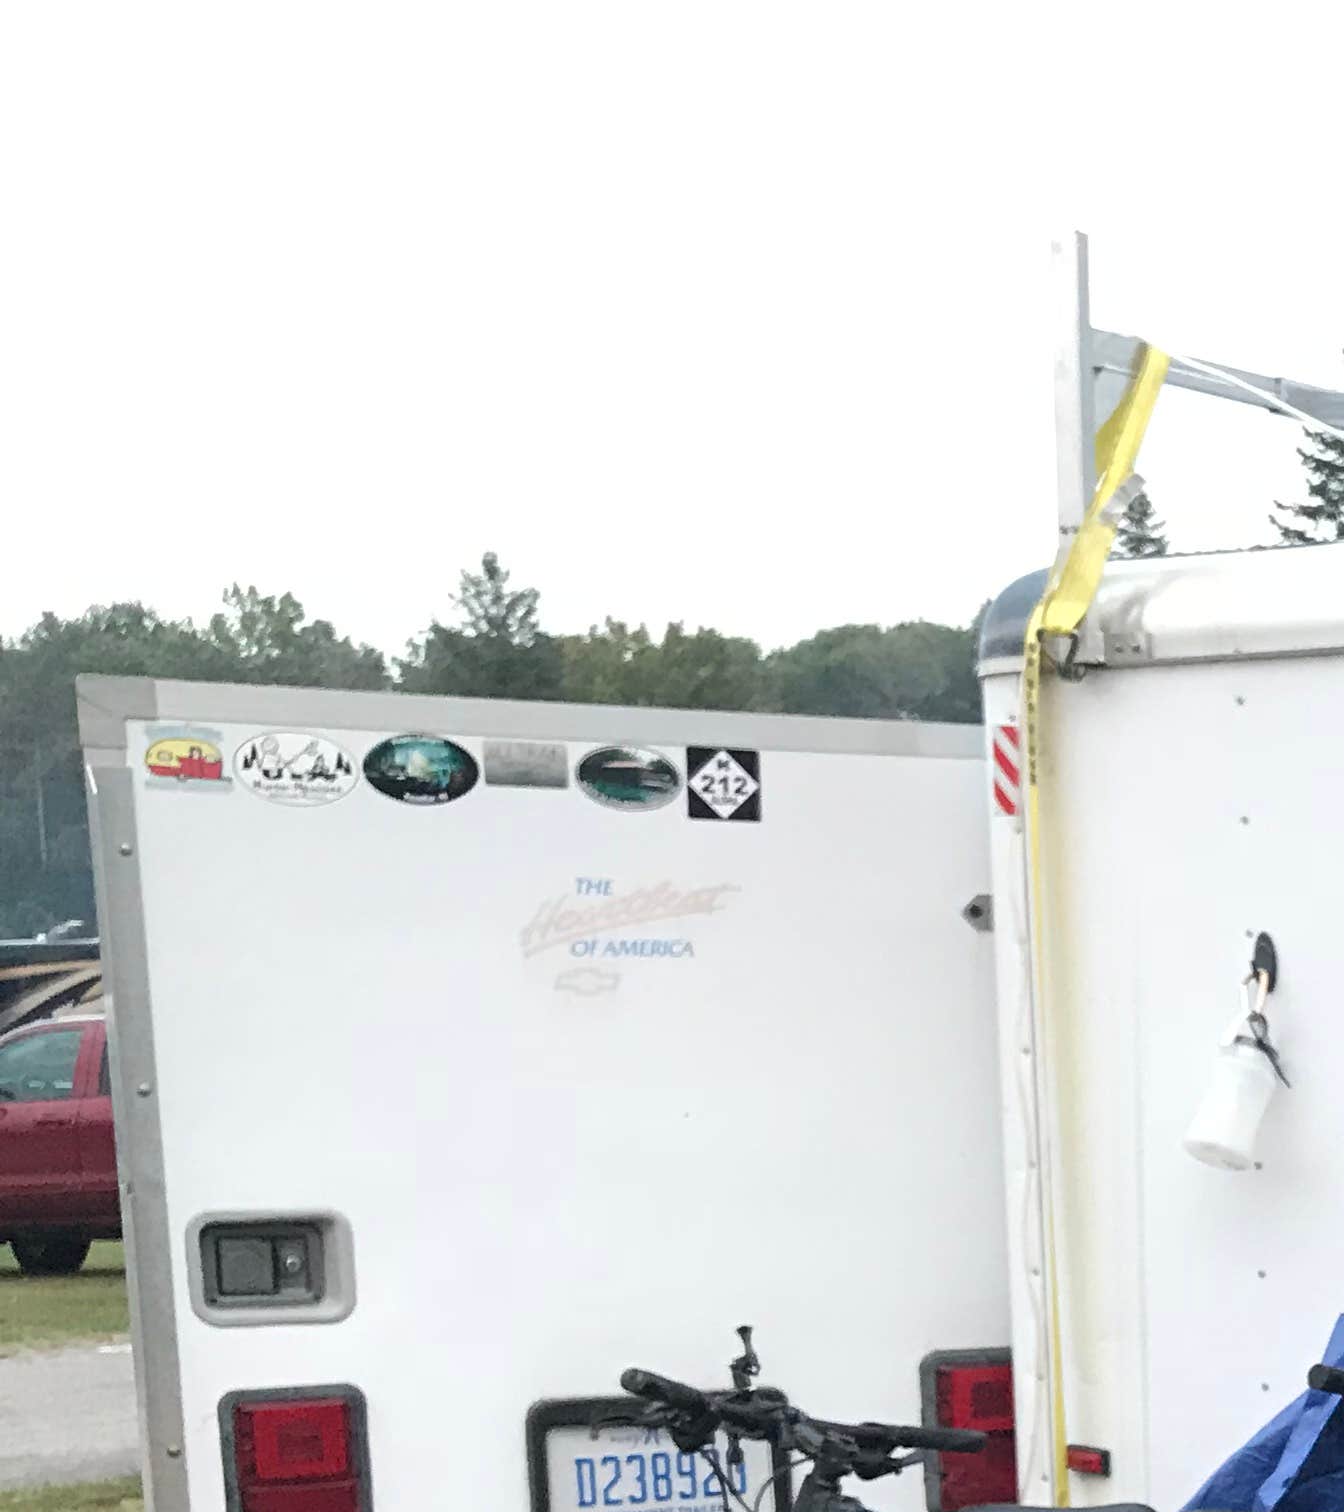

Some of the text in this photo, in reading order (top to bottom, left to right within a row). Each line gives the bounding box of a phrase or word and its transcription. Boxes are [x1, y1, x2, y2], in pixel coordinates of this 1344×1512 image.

[702, 775, 749, 796] 212
[575, 877, 614, 896] THE
[570, 938, 695, 958] OF AMERICA
